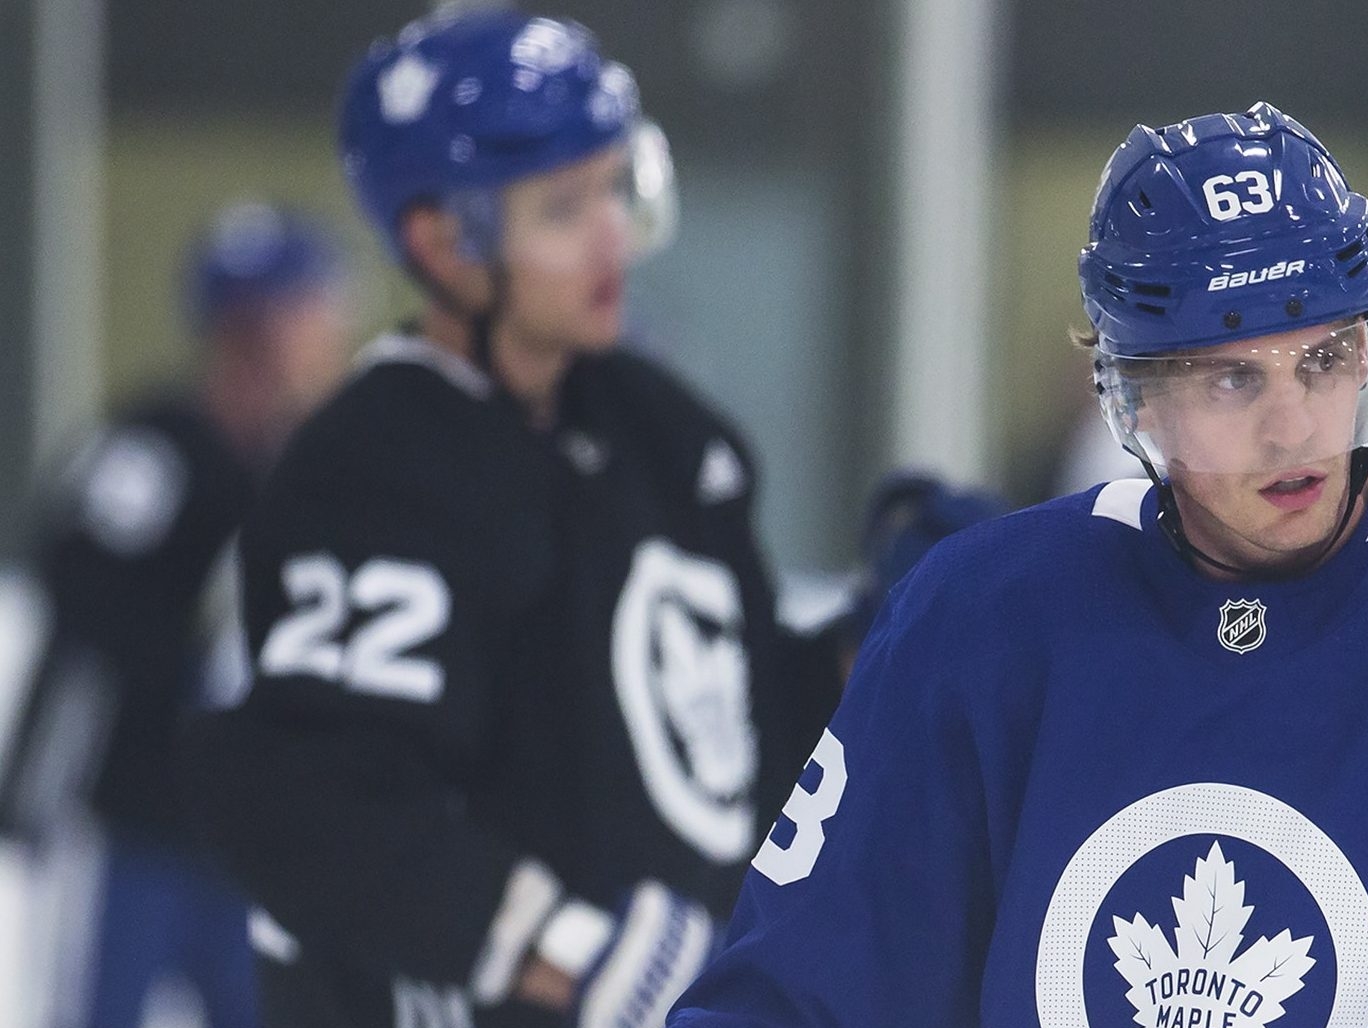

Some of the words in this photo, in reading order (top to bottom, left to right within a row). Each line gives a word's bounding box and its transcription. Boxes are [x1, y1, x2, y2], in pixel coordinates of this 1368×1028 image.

[1202, 170, 1275, 221] 63
[258, 551, 452, 702] 22
[1228, 612, 1257, 642] NHL
[1144, 968, 1264, 1018] TORONTO
